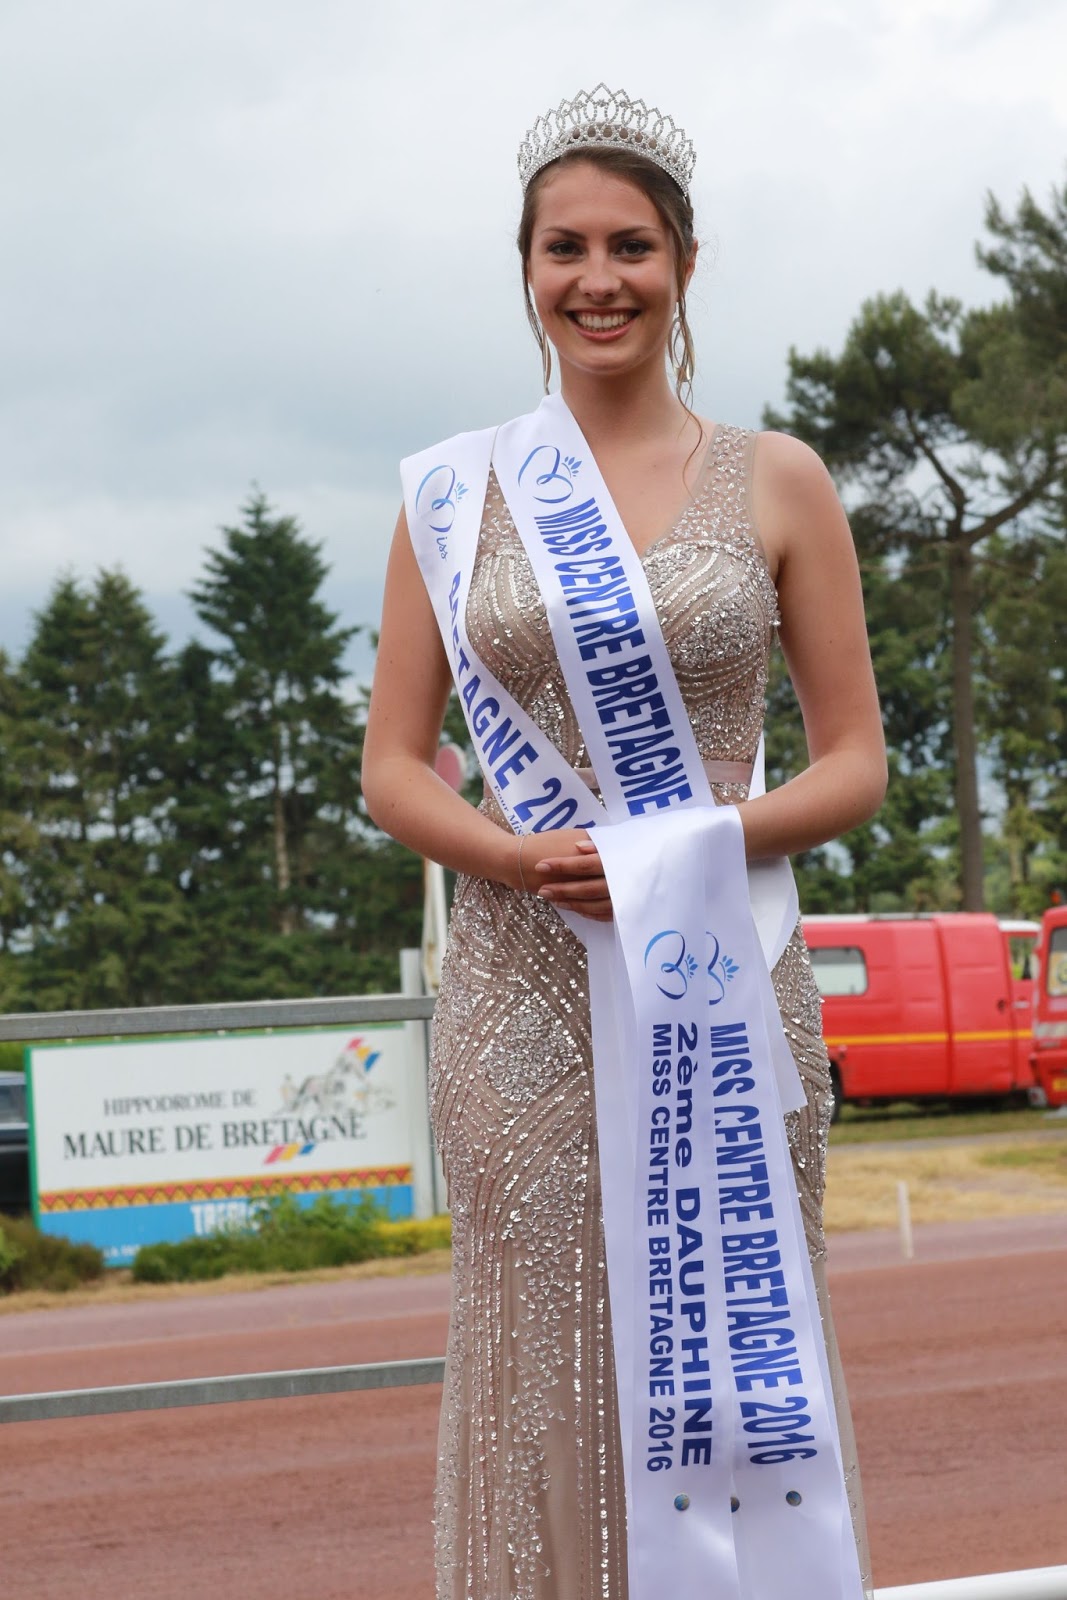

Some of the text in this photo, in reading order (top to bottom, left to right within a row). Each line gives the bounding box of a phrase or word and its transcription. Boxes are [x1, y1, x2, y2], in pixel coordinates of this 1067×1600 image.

[534, 497, 693, 817] MISS CENTRE BRETAGNE
[63, 1107, 367, 1160] MAURE DE BRETAGNE
[103, 1089, 256, 1116] HIPPODROME DE
[713, 1105, 775, 1224] CENTRE
[646, 1023, 676, 1472] MISS CENTRE BRETAGNE 2016
[722, 1229, 803, 1392] BRETAGNE
[676, 1187, 713, 1467] DAUPHINE
[739, 1396, 817, 1465] 2016
